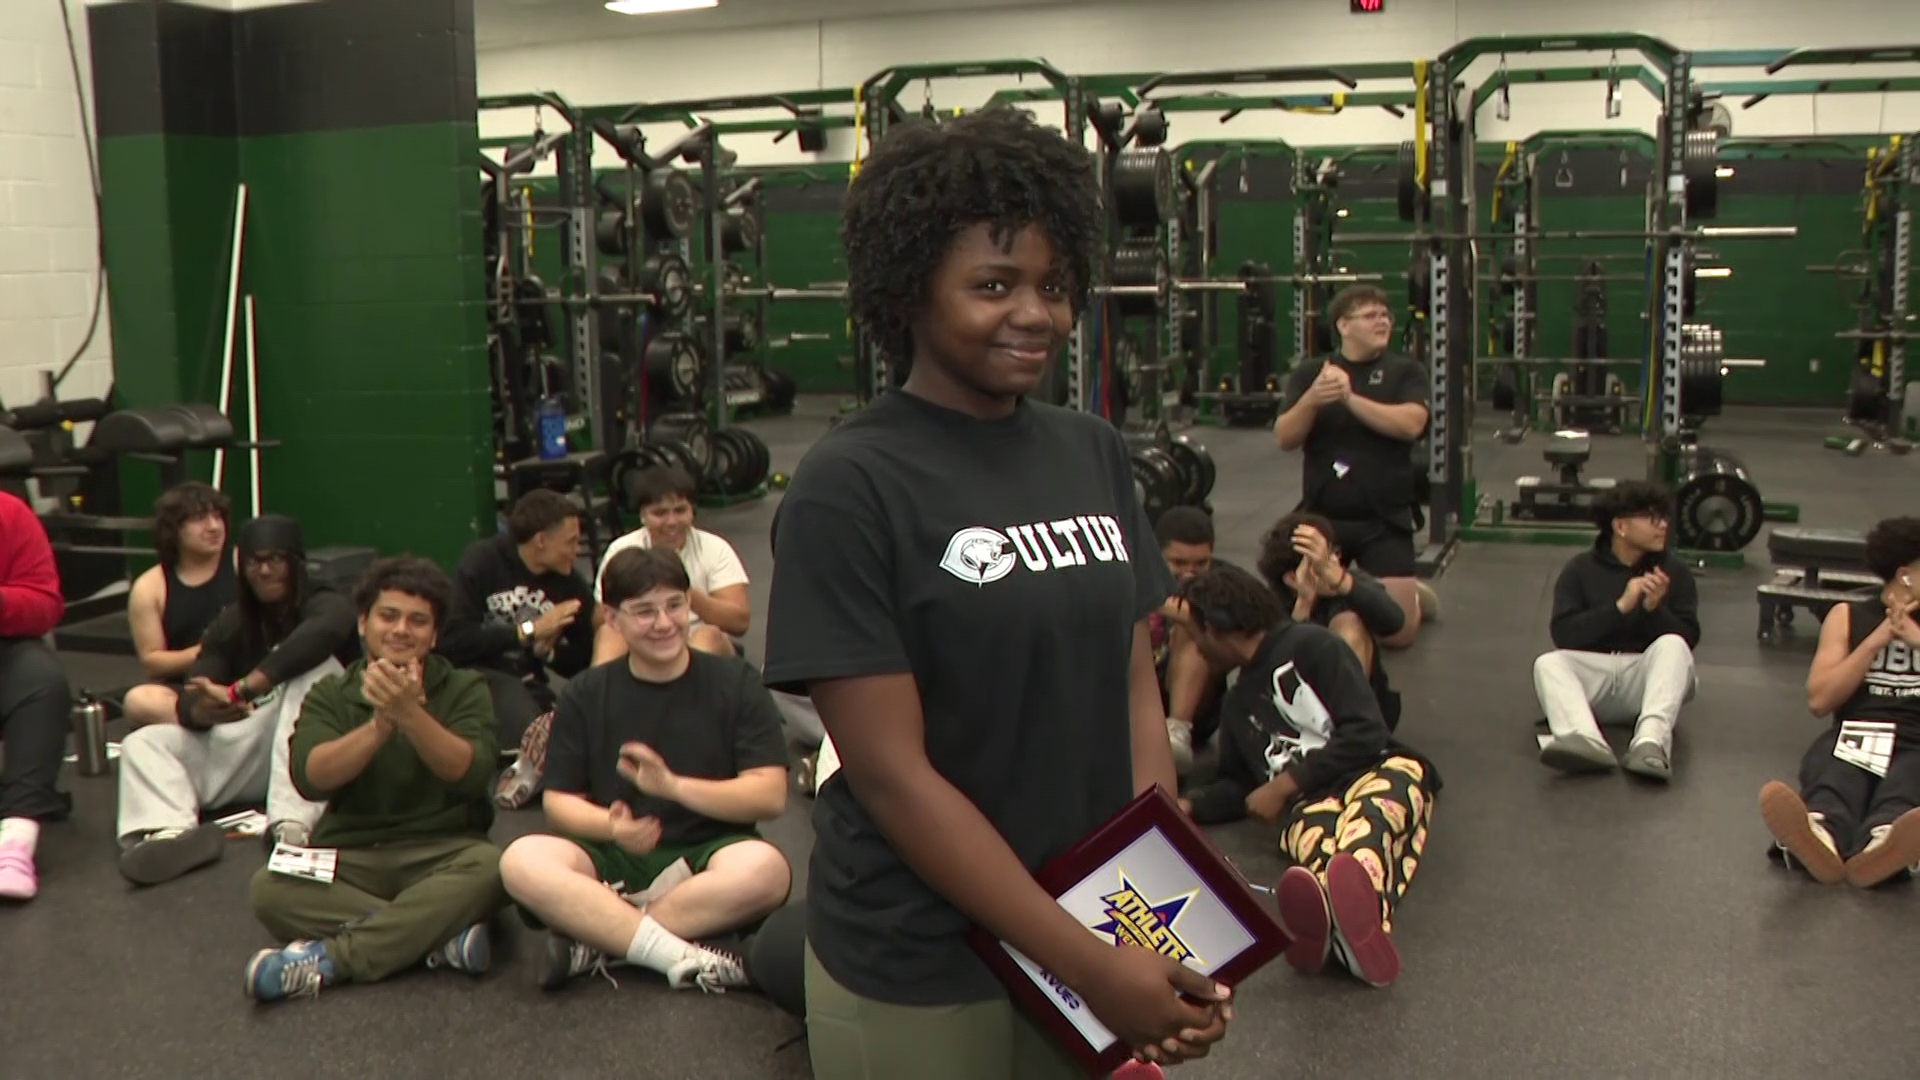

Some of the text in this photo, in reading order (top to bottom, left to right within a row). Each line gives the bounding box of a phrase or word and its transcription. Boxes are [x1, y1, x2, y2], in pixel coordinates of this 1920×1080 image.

[939, 514, 1129, 588] CULTUR
[1104, 889, 1188, 960] ATHLETE
[1115, 922, 1137, 947] WEE
